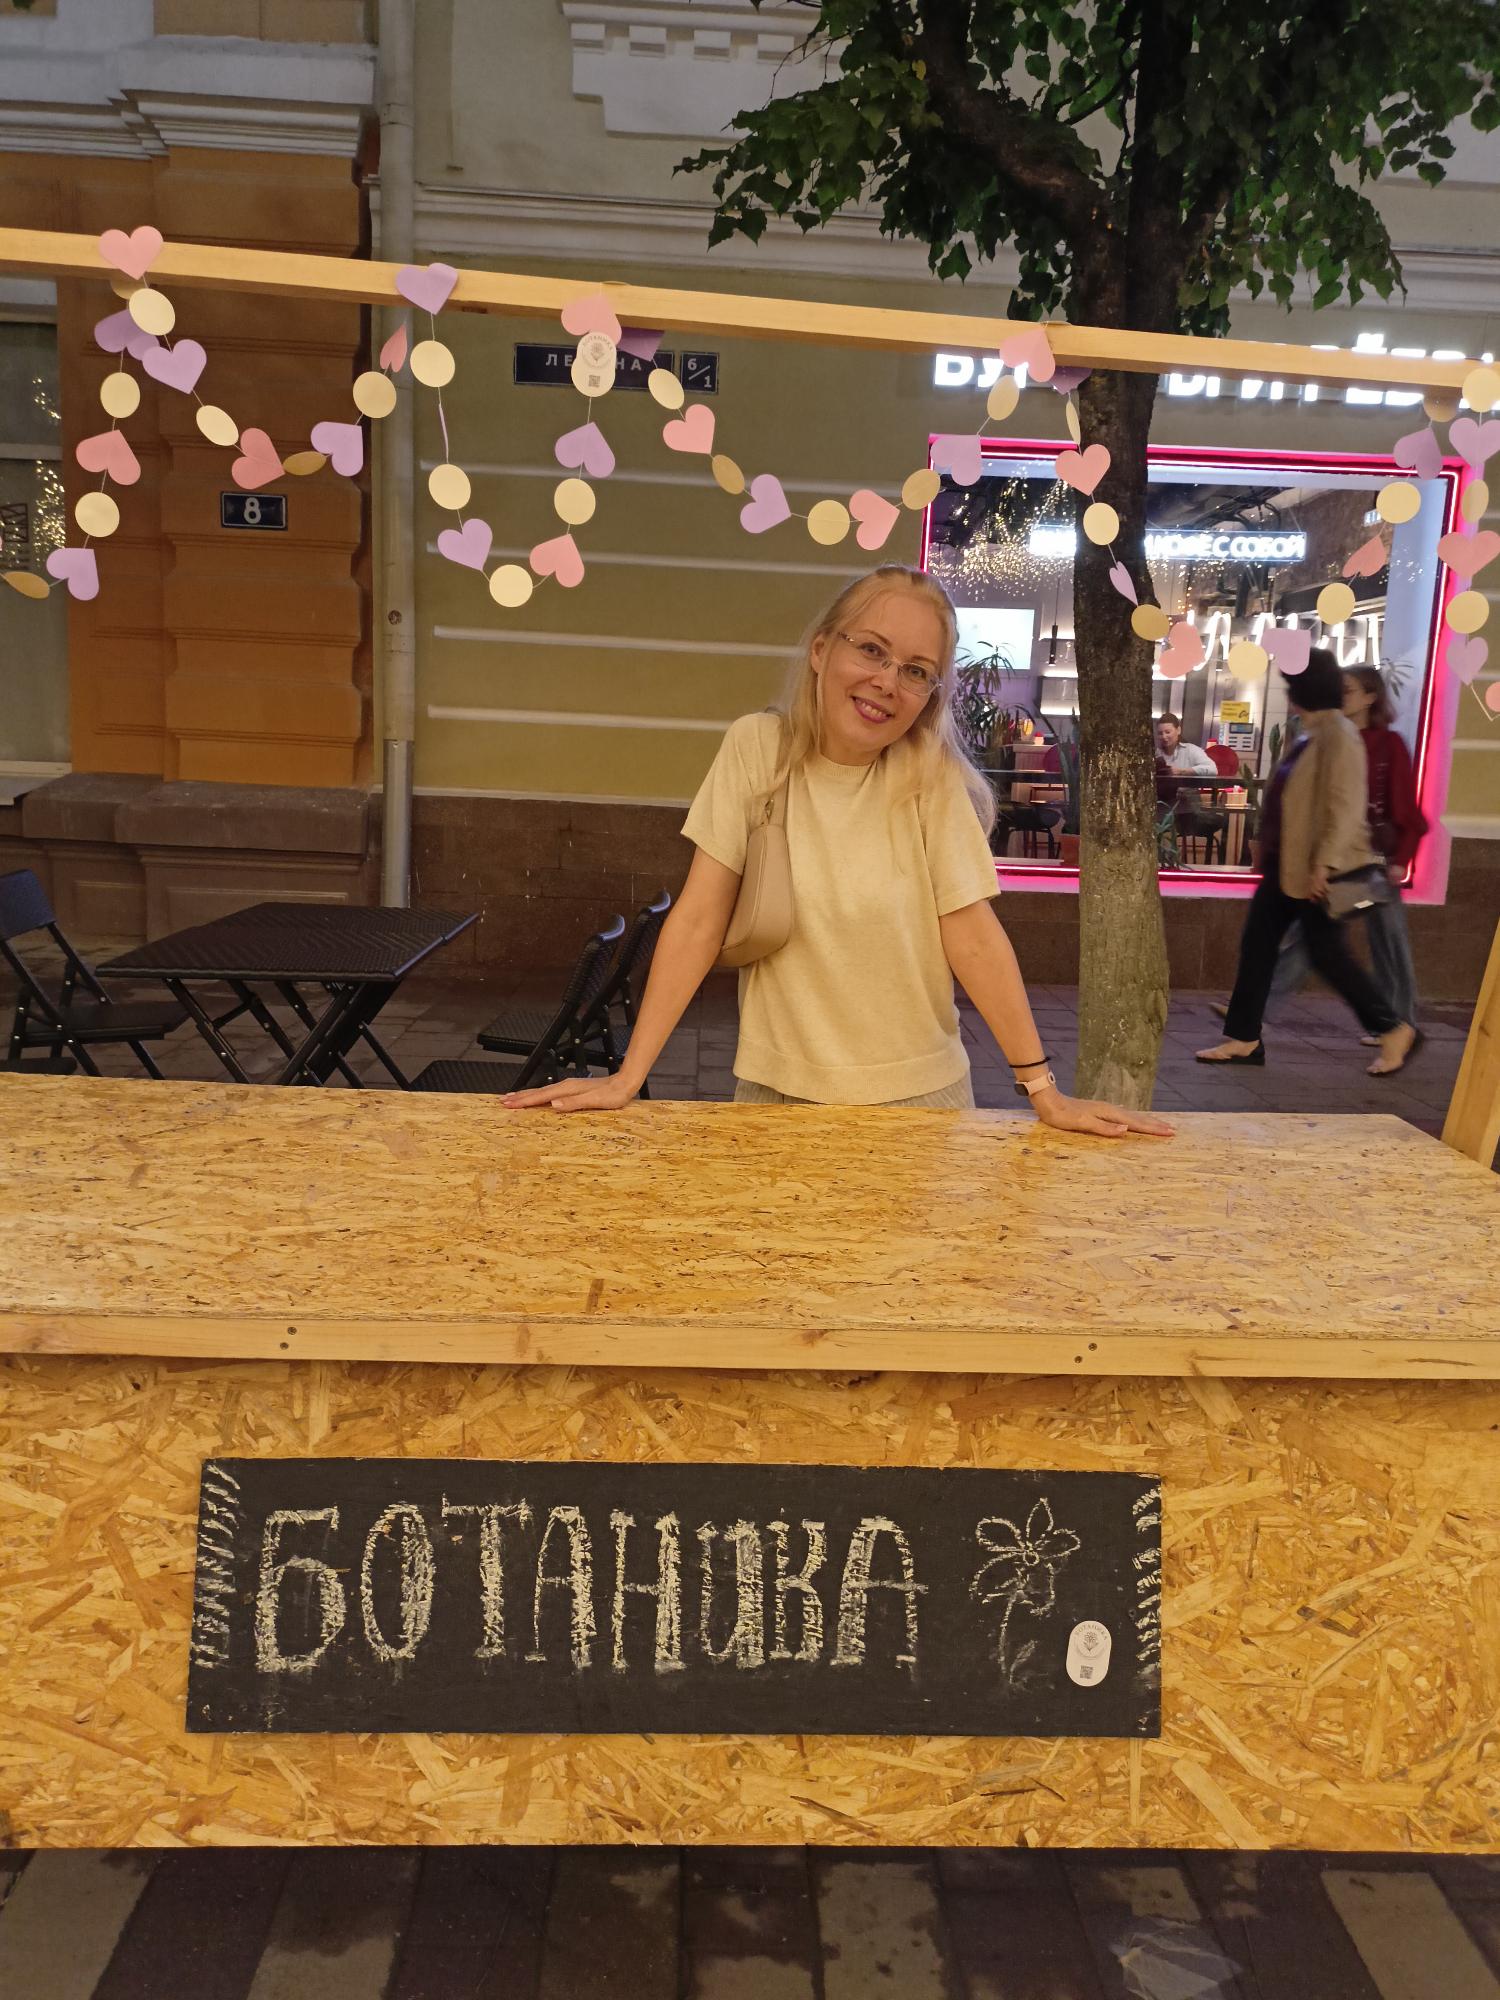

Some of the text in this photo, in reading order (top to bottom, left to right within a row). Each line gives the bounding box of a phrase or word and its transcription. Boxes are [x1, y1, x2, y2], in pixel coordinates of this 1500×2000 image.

[545, 354, 642, 371] ЛЕНА
[243, 497, 262, 524] 8
[254, 1495, 929, 1673] БОТАНИКА
